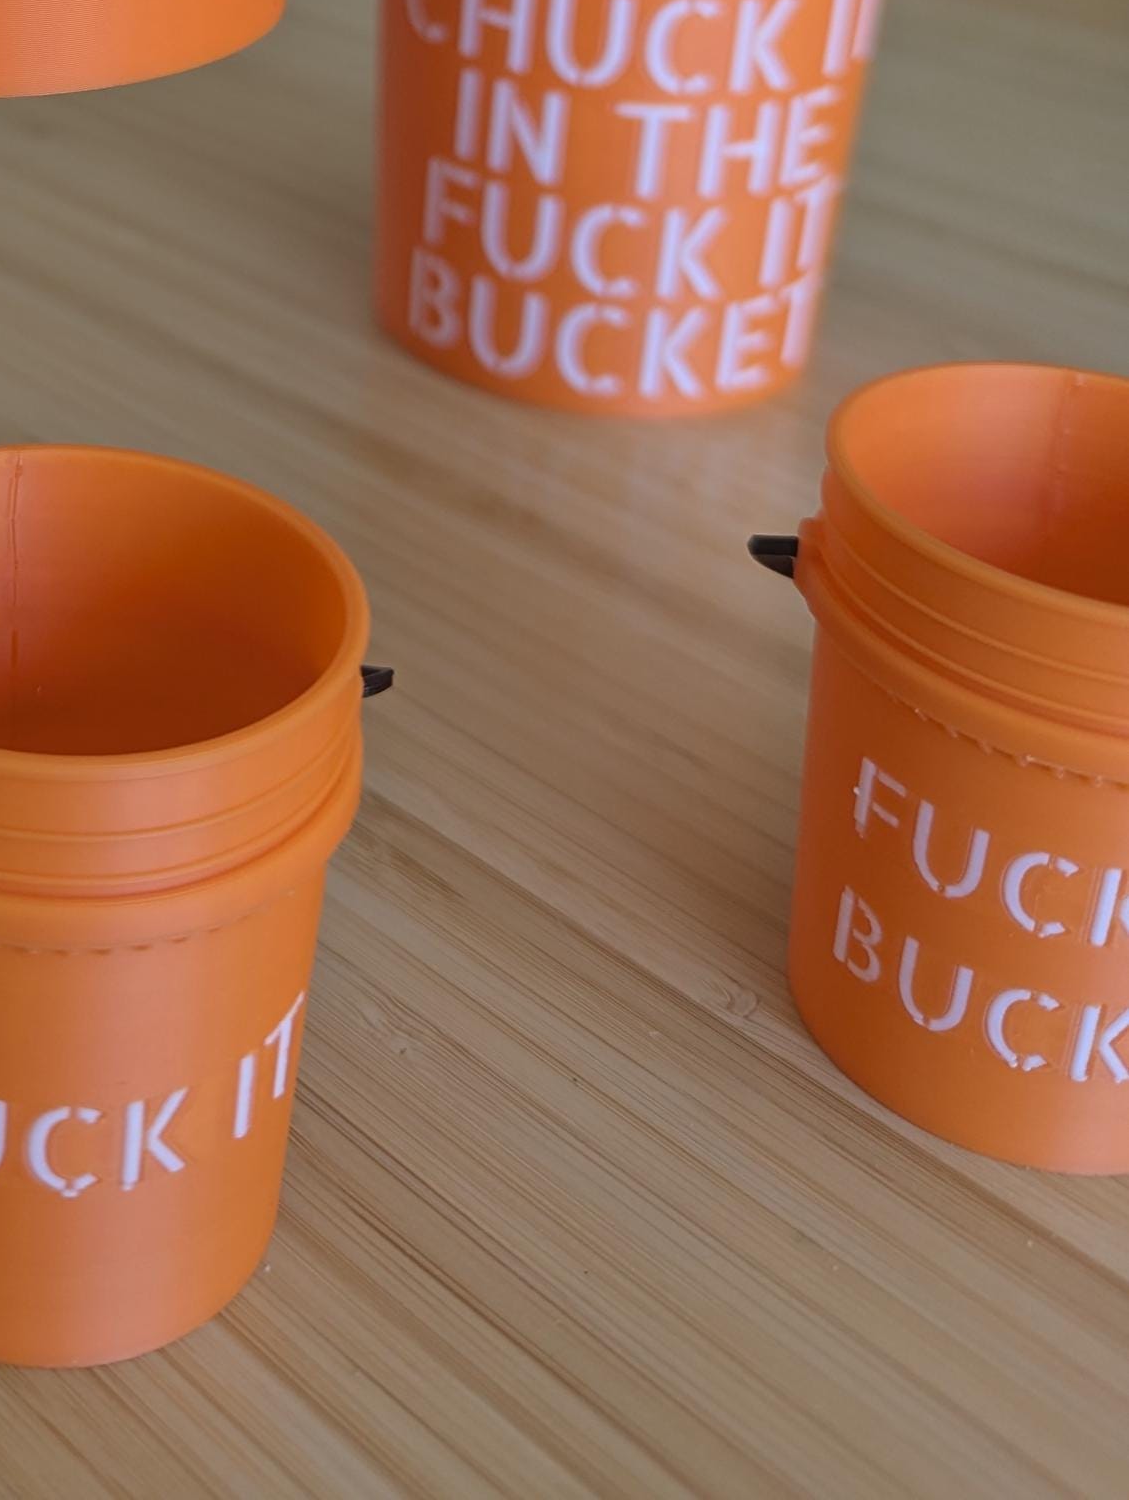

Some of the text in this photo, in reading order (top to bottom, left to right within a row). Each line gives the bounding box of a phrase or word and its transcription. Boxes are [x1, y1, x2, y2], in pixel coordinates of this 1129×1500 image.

[455, 66, 841, 200] IN THE
[421, 155, 843, 302] FUCK IT
[407, 245, 822, 399] BUCKET
[233, 991, 305, 1140] IT
